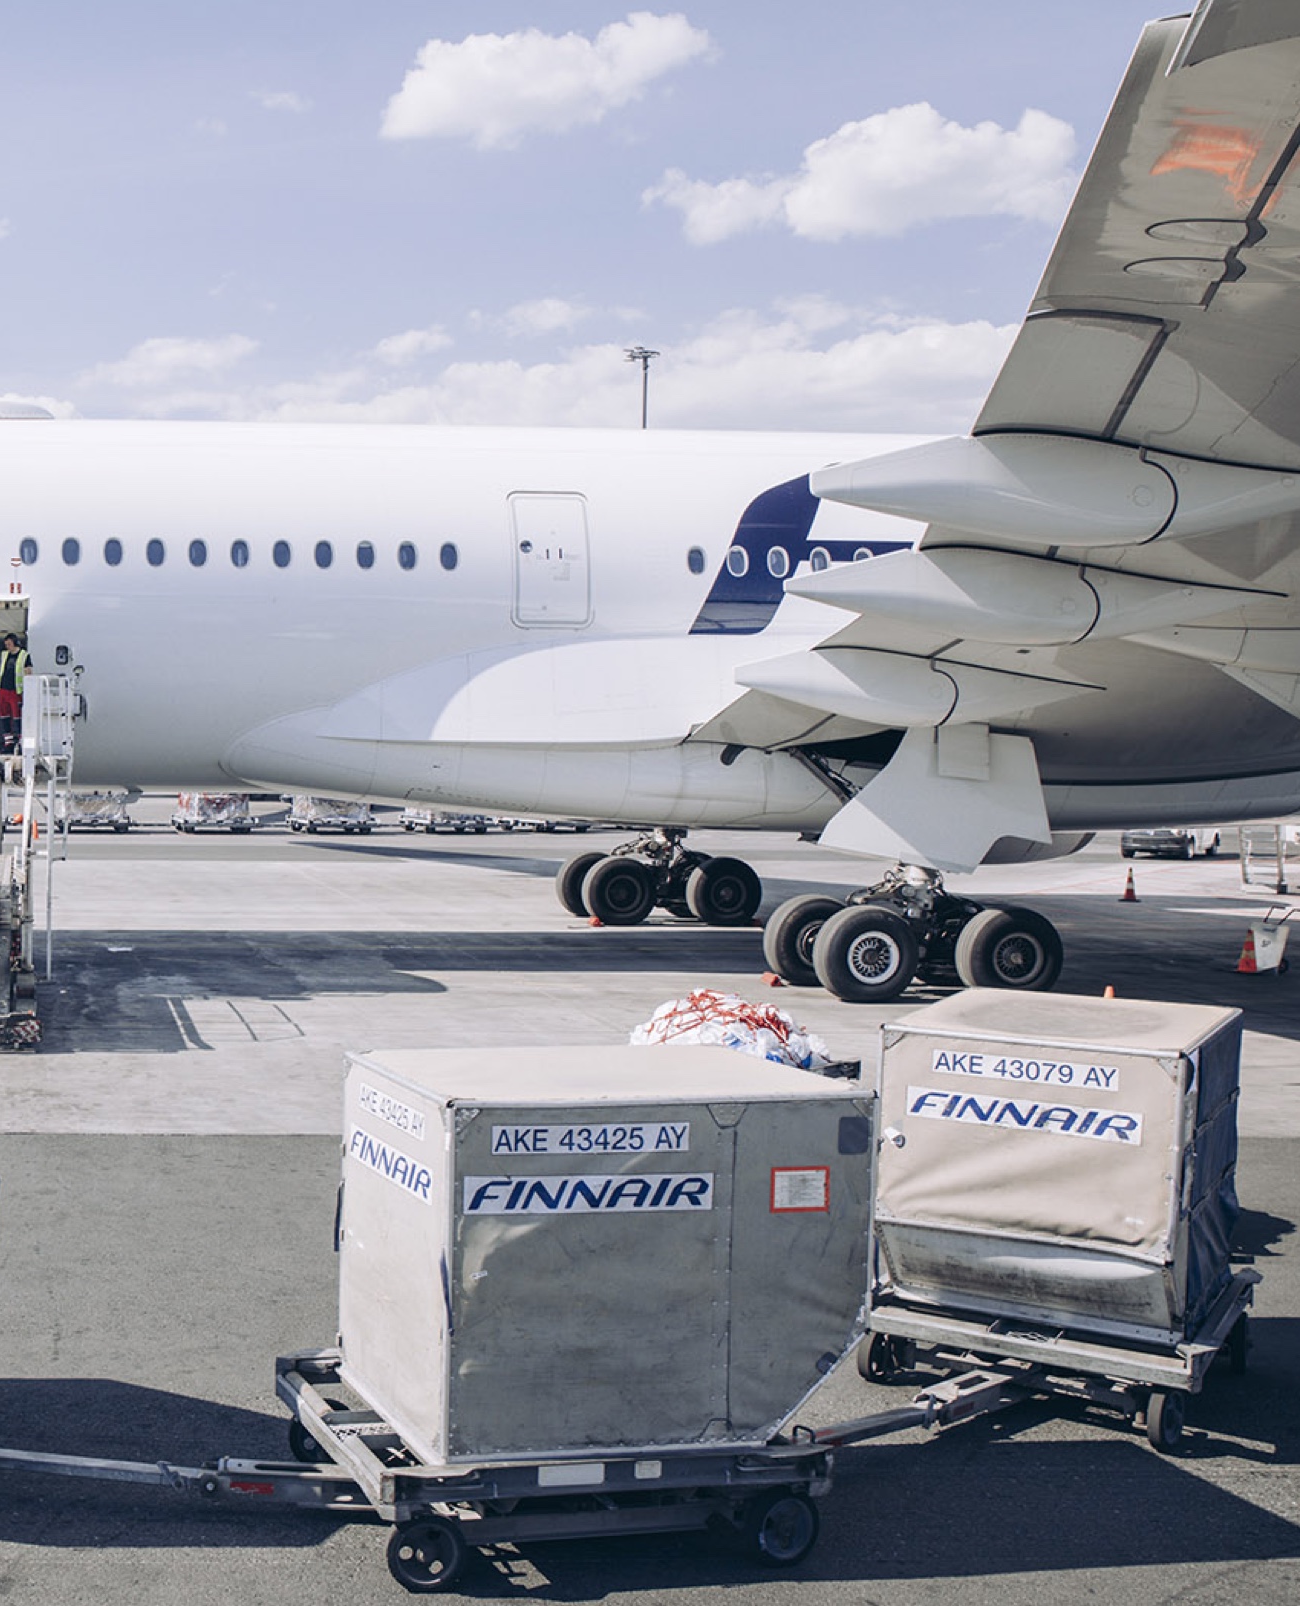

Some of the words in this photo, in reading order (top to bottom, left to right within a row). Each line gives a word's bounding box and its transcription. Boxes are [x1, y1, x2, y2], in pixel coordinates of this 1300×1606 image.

[934, 1052, 983, 1075] AKE
[993, 1058, 1074, 1084] 43079
[1082, 1066, 1116, 1088] AY
[910, 1091, 1139, 1140] FINNAIR
[494, 1128, 549, 1152] AKE
[559, 1126, 644, 1151] 43425
[655, 1125, 687, 1149] AY
[350, 1129, 432, 1199] FINNAIR
[468, 1177, 709, 1210] FINNAIR
